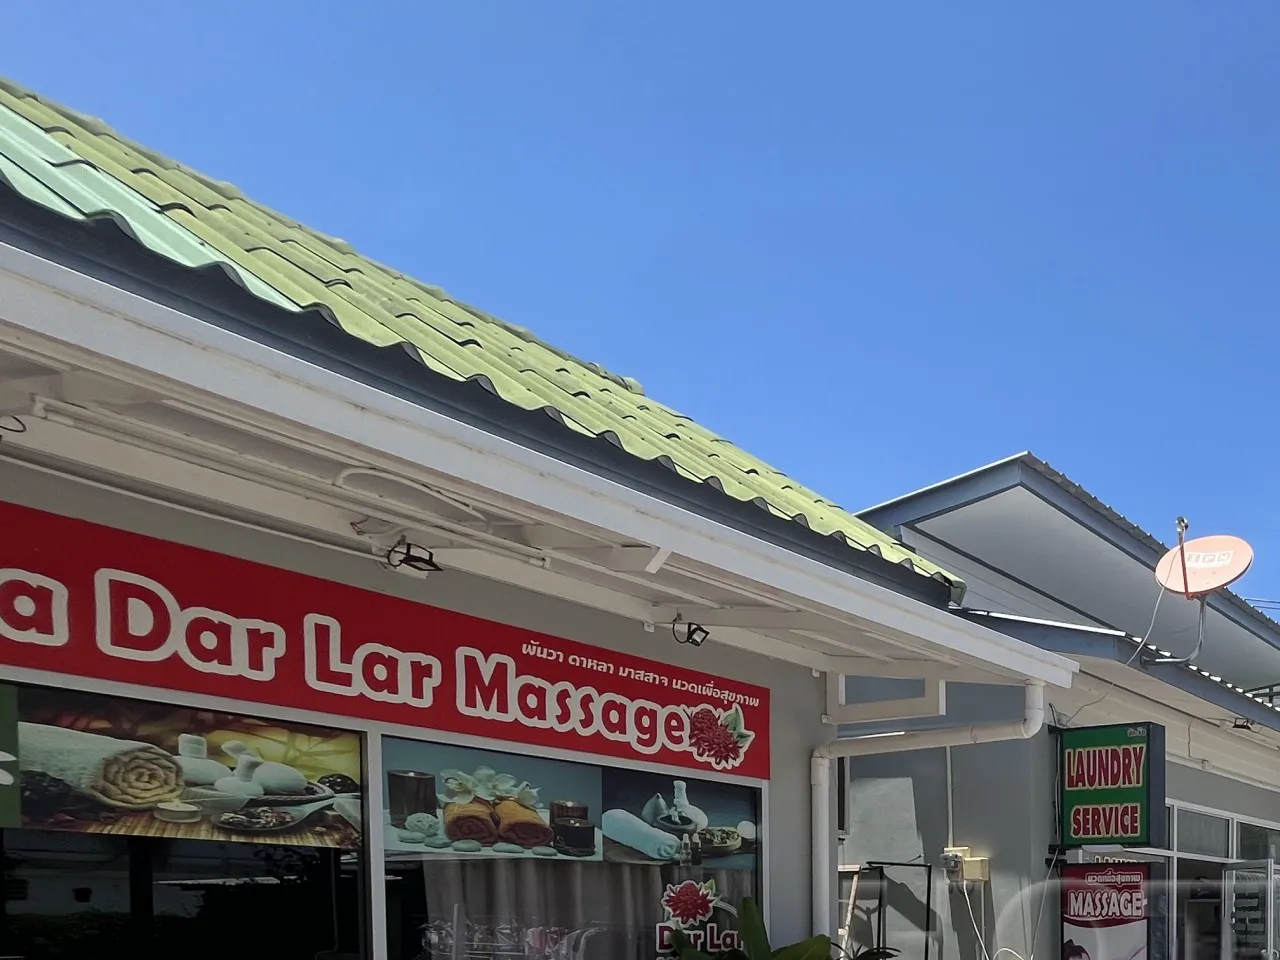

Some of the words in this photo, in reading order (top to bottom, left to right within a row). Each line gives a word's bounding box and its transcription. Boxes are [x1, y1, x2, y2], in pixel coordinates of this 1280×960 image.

[95, 567, 286, 680] Dar
[303, 612, 441, 707] Lar
[455, 646, 697, 755] Massage
[521, 641, 564, 663] พันวา
[568, 655, 614, 674] ดาหลา
[1065, 745, 1144, 790] LAUNDRY
[1070, 803, 1141, 838] SERVICE
[1068, 890, 1144, 919] MASSAGE
[656, 923, 704, 953] Dr
[706, 922, 744, 953] La
